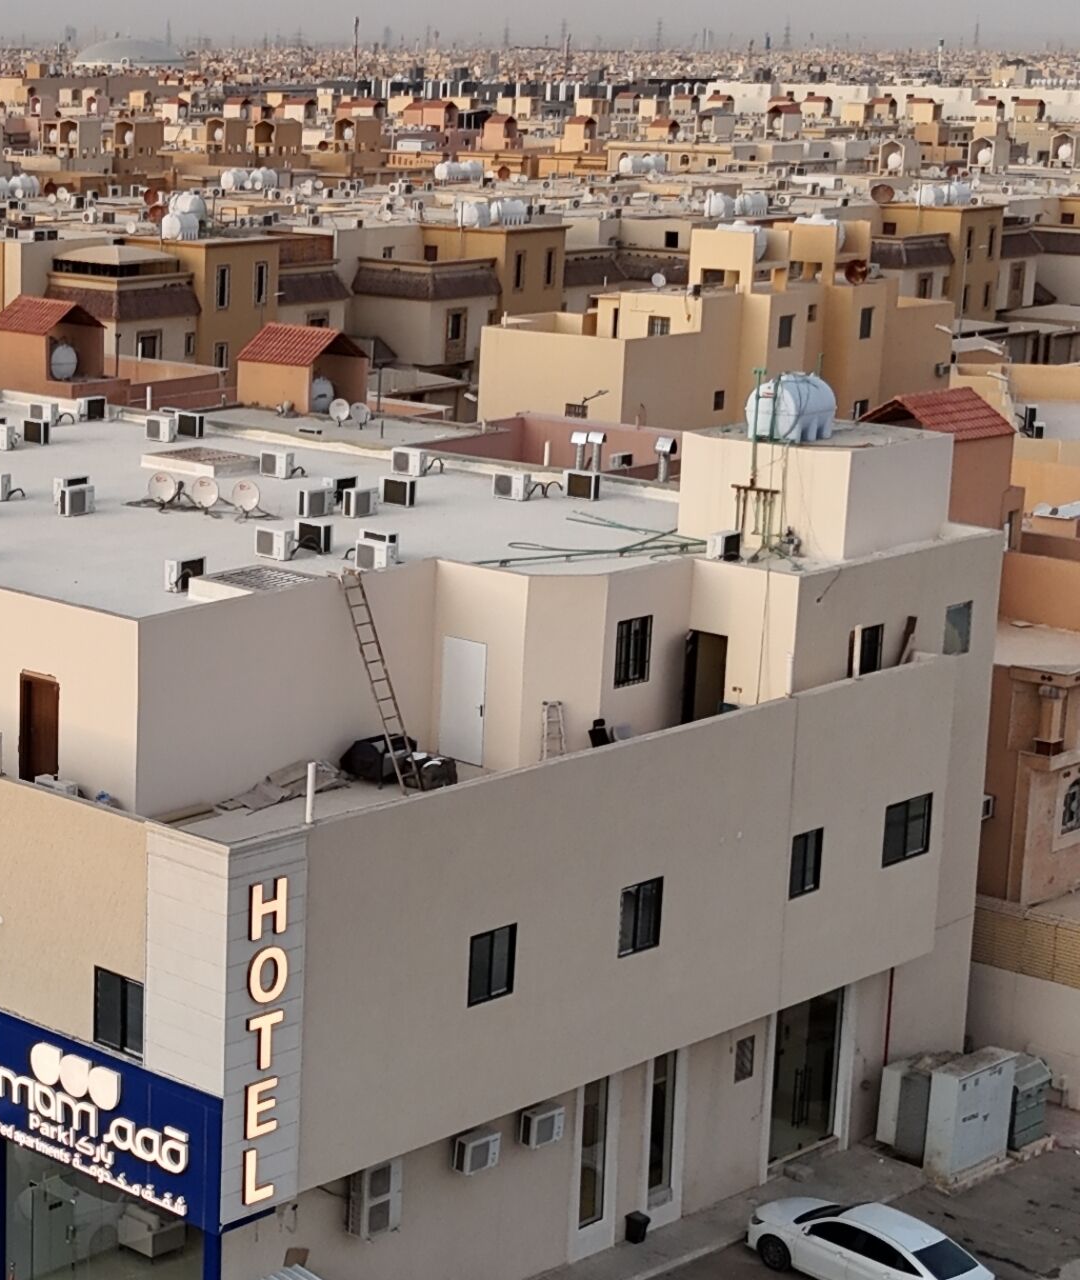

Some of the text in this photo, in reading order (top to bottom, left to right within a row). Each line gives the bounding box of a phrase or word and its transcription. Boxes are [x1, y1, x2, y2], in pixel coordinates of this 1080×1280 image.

[240, 876, 288, 1206] HOTEL
[29, 1112, 70, 1146] Park
[13, 1130, 72, 1165] apartments
